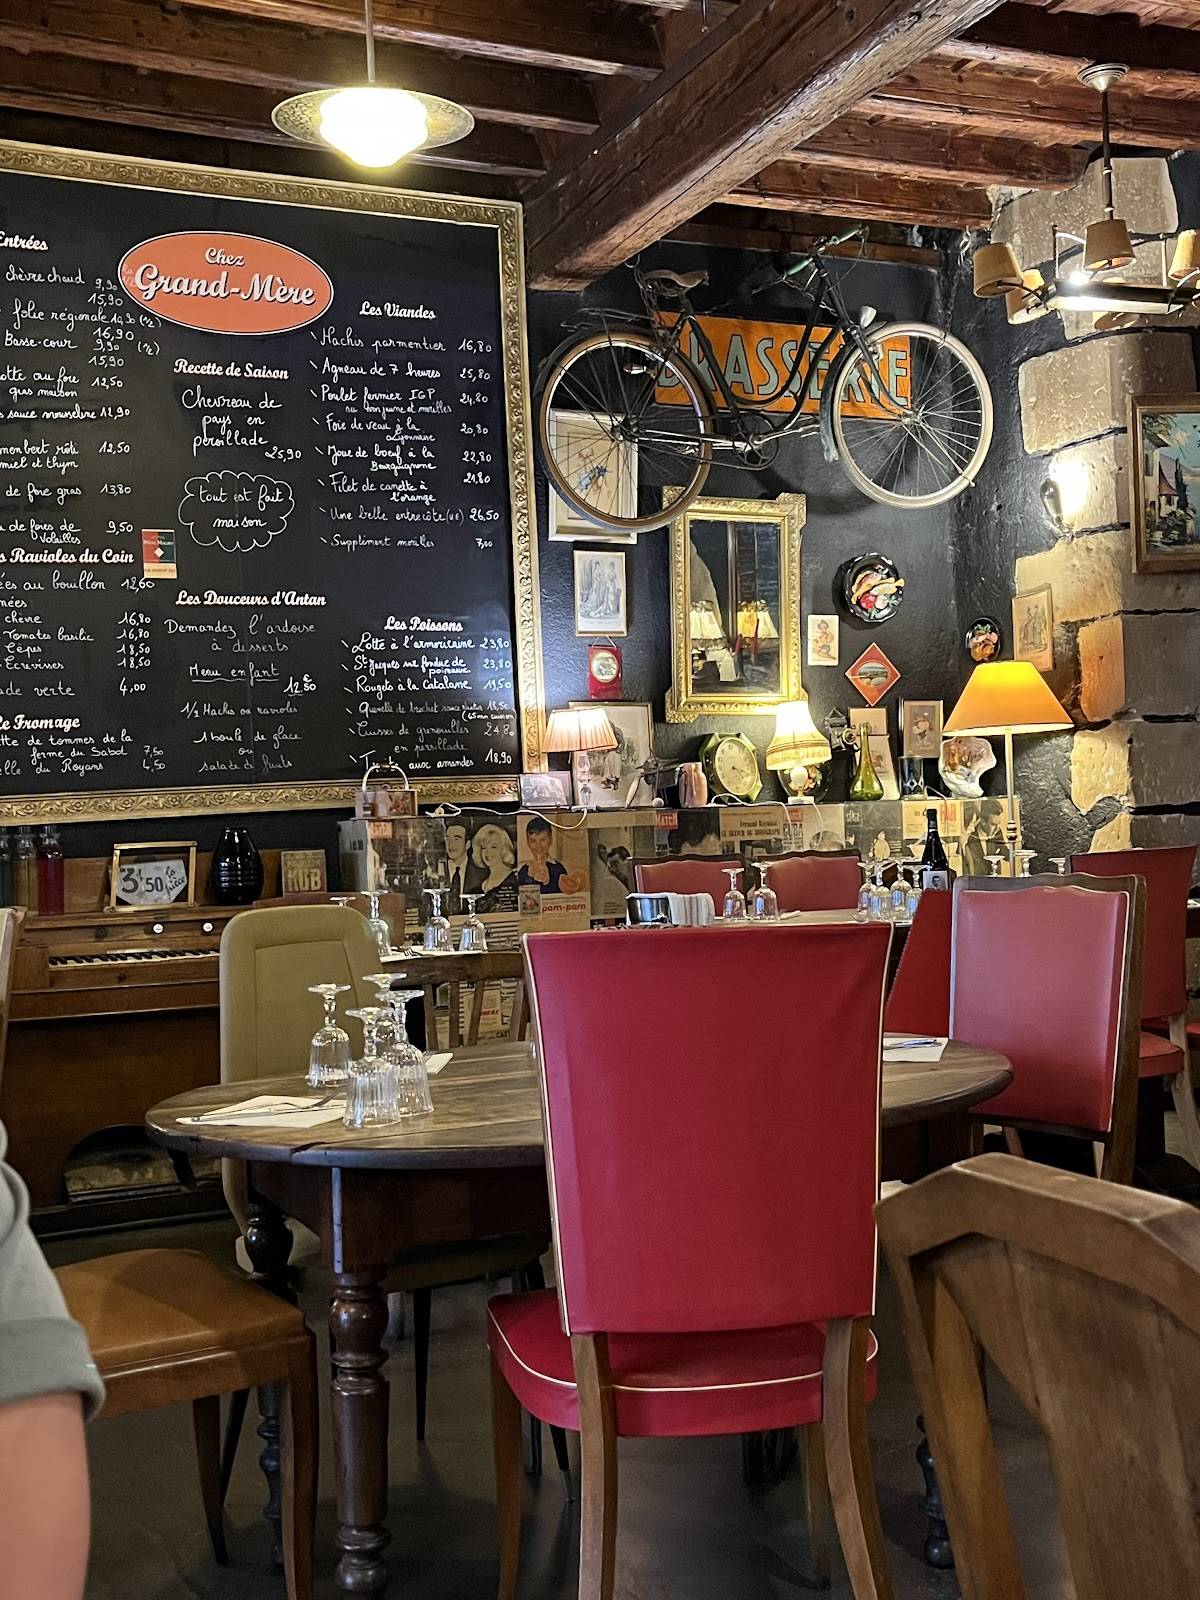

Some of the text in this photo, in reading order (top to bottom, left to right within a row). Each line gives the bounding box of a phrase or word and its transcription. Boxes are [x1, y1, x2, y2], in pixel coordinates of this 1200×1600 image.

[205, 248, 245, 266] Chez
[47, 267, 84, 283] chaud
[134, 264, 316, 305] Grand-Mère
[88, 294, 123, 307] 15,90
[359, 301, 436, 319] Les Viandes
[51, 307, 109, 331] régionale
[93, 328, 134, 342] 16,90
[320, 326, 492, 353] Hachis parmentier 16,80
[89, 356, 124, 367] 15,90
[174, 359, 289, 380] Recette de Saison
[322, 357, 490, 383] Agneau de 7 heures 25,80
[91, 376, 123, 388] 12,50
[182, 385, 283, 409] Chevreau de
[321, 384, 357, 401] Poulet
[364, 387, 402, 404] fermier
[409, 389, 435, 399] IGP
[100, 407, 130, 420] 12,90
[326, 413, 346, 431] Foie
[351, 417, 362, 430] de
[366, 422, 391, 430] veau
[407, 417, 420, 430] la
[202, 415, 265, 434] pays en
[99, 442, 130, 454] 12,50
[194, 431, 268, 456] persillade
[265, 447, 301, 462] 25,90
[355, 446, 368, 457] de
[408, 448, 416, 457] à
[422, 446, 435, 457] la
[462, 451, 491, 465] 22,80
[32, 457, 42, 468] et
[47, 458, 78, 475] thym
[329, 472, 358, 492] Filet
[362, 477, 377, 491] de
[420, 481, 427, 490] à
[6, 485, 21, 497] de
[57, 487, 82, 505] gras
[100, 484, 131, 496] 13,80
[199, 484, 284, 511] tout est fait
[213, 516, 267, 528] maison
[330, 507, 352, 520] Une
[359, 505, 388, 520] belle
[396, 508, 446, 522] entrecôte
[9, 520, 26, 531] de
[60, 519, 81, 531] de
[106, 521, 133, 535] 9,50
[9, 548, 77, 563] Ravioles
[79, 549, 99, 563] du
[102, 549, 134, 563] Coin
[23, 581, 44, 590] au
[53, 570, 106, 590] bouillon
[176, 590, 326, 606] Les Douceurs d'Antan
[118, 612, 151, 626] 16,80
[384, 616, 463, 631] Les Poissons
[3, 627, 149, 642] Tomates basilic 16,80
[164, 619, 236, 639] Demandez
[117, 644, 150, 656] 18,50
[212, 637, 288, 652] à desserts
[352, 632, 385, 653] Lotte
[391, 639, 399, 650] à
[480, 637, 509, 651] 23,80
[117, 658, 151, 669] 18,50
[451, 656, 466, 667] de
[483, 658, 511, 670] 23,80
[189, 662, 279, 686] Menu enfant
[34, 677, 146, 696] verte 4,00
[357, 675, 393, 700] Rougets
[398, 679, 406, 690] à
[407, 678, 417, 690] la
[423, 676, 472, 690] Catalane
[13, 715, 81, 732] Fromage
[399, 723, 408, 734] de
[28, 735, 43, 746] de
[48, 735, 94, 745] tommes
[103, 733, 117, 743] de
[121, 729, 133, 742] la
[210, 728, 242, 742] boule
[254, 731, 266, 741] de
[70, 747, 85, 756] du
[395, 745, 408, 753] en
[437, 756, 473, 767] amandes
[485, 748, 512, 764] 18,90
[36, 762, 51, 774] du
[62, 758, 103, 777] Royans
